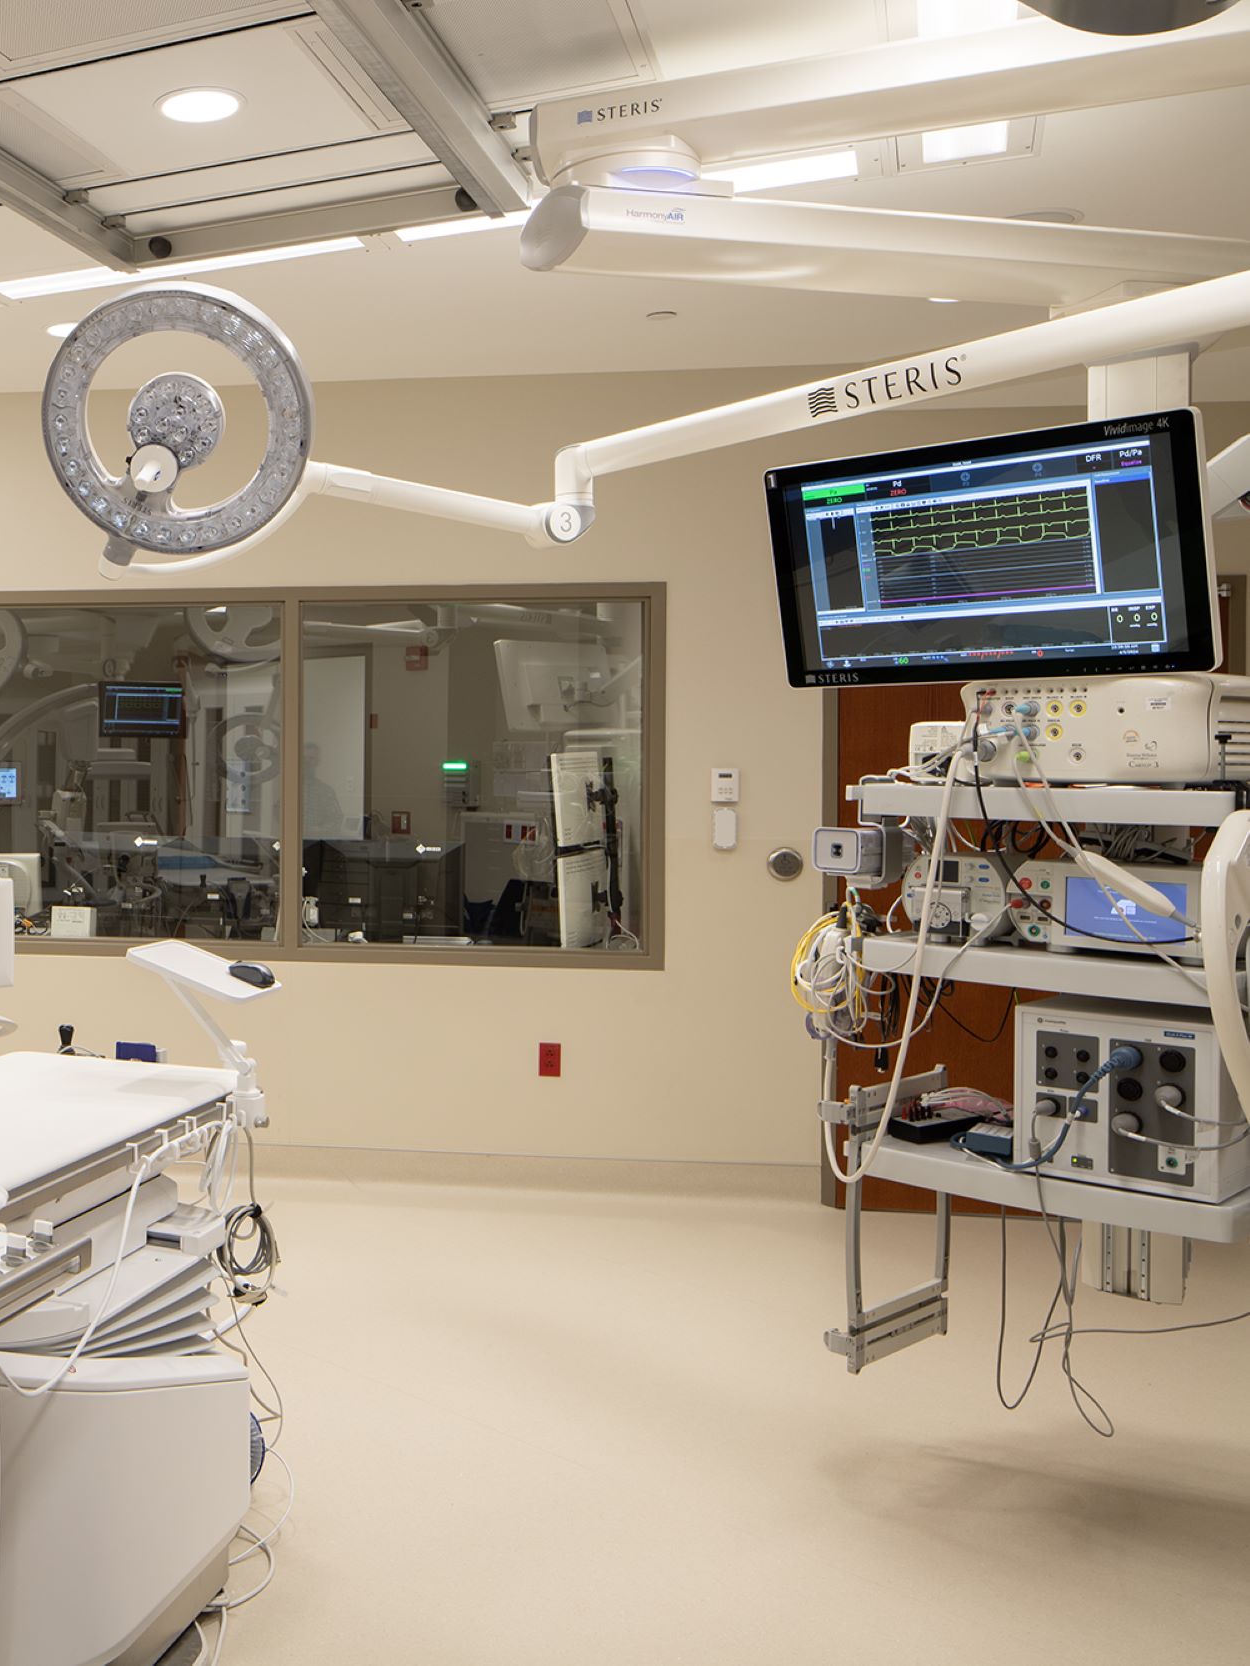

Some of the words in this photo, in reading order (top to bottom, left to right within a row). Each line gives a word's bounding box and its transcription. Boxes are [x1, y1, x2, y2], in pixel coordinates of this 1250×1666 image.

[597, 99, 661, 122] STERIS
[626, 209, 685, 222] HarmonyAIR
[844, 356, 963, 409] STERIS
[1156, 416, 1170, 429] 4K
[1085, 454, 1102, 463] DFR
[1119, 449, 1143, 459] Pd/Pa
[892, 480, 903, 488] Pd
[890, 489, 907, 497] ZERO
[826, 497, 843, 505] ZERO
[560, 511, 572, 533] 3
[818, 673, 860, 684] STERIS
